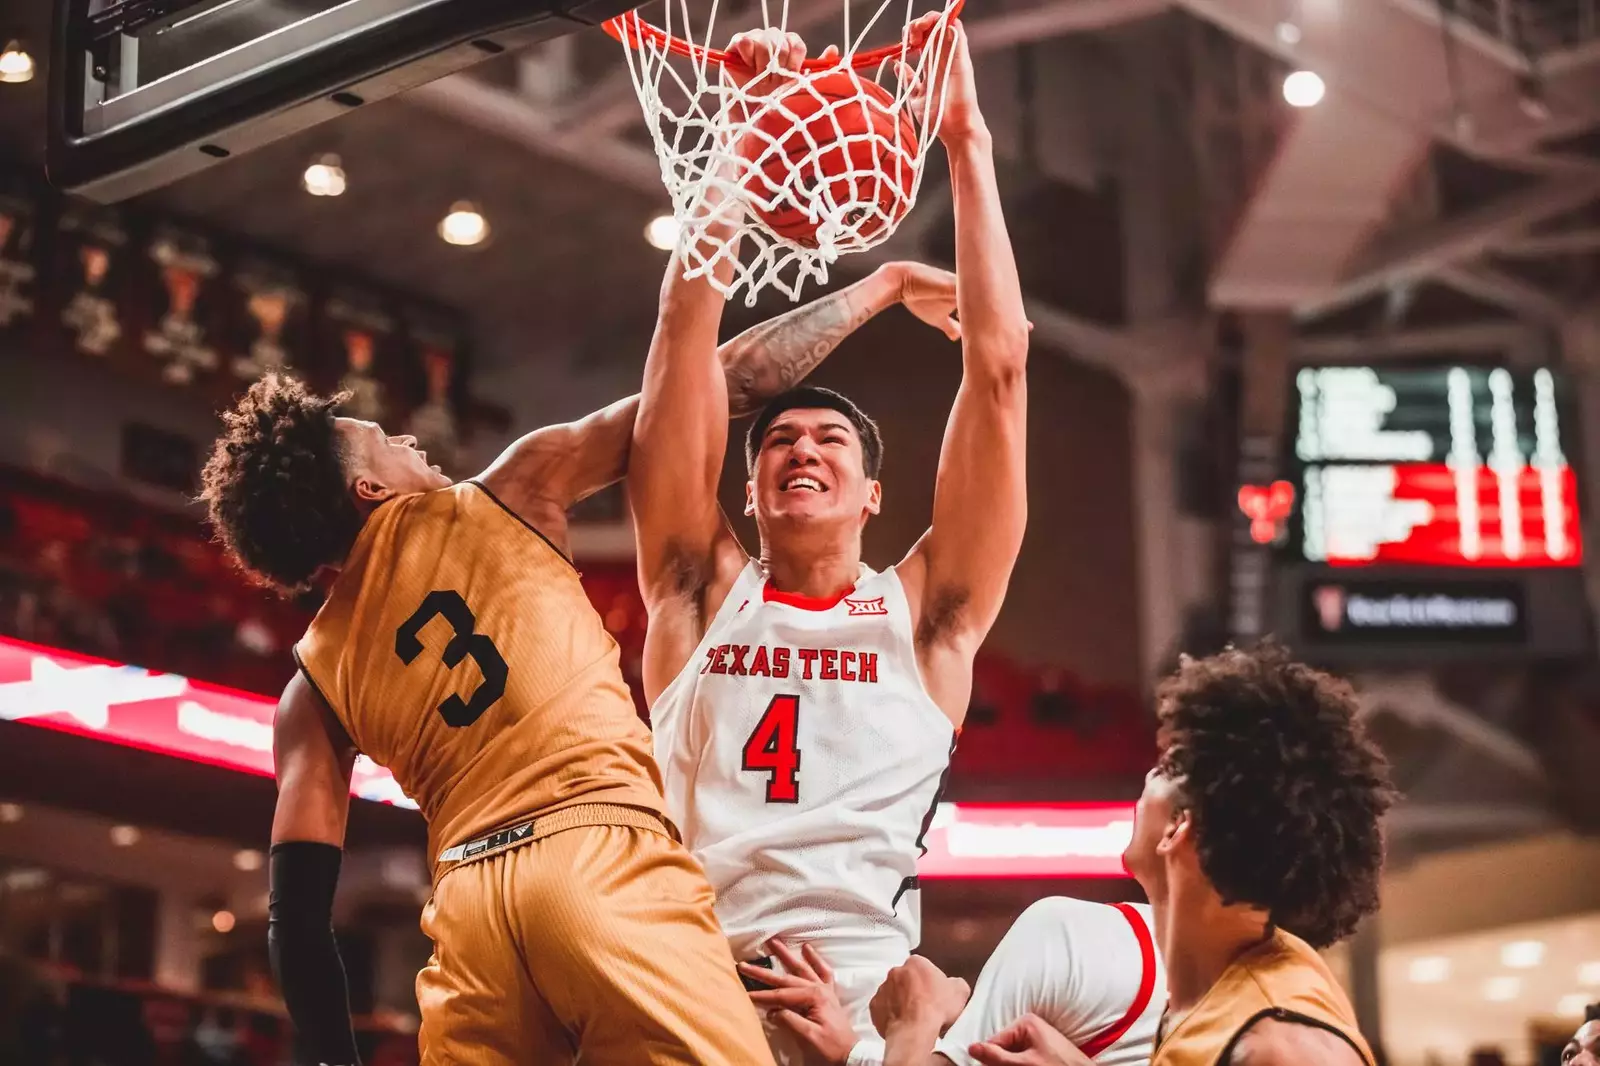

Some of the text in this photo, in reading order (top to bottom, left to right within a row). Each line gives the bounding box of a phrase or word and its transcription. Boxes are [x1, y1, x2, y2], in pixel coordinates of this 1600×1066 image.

[844, 596, 888, 616] XII
[395, 590, 509, 728] 3
[700, 644, 878, 683] TEXAS TECH
[741, 693, 801, 804] 4
